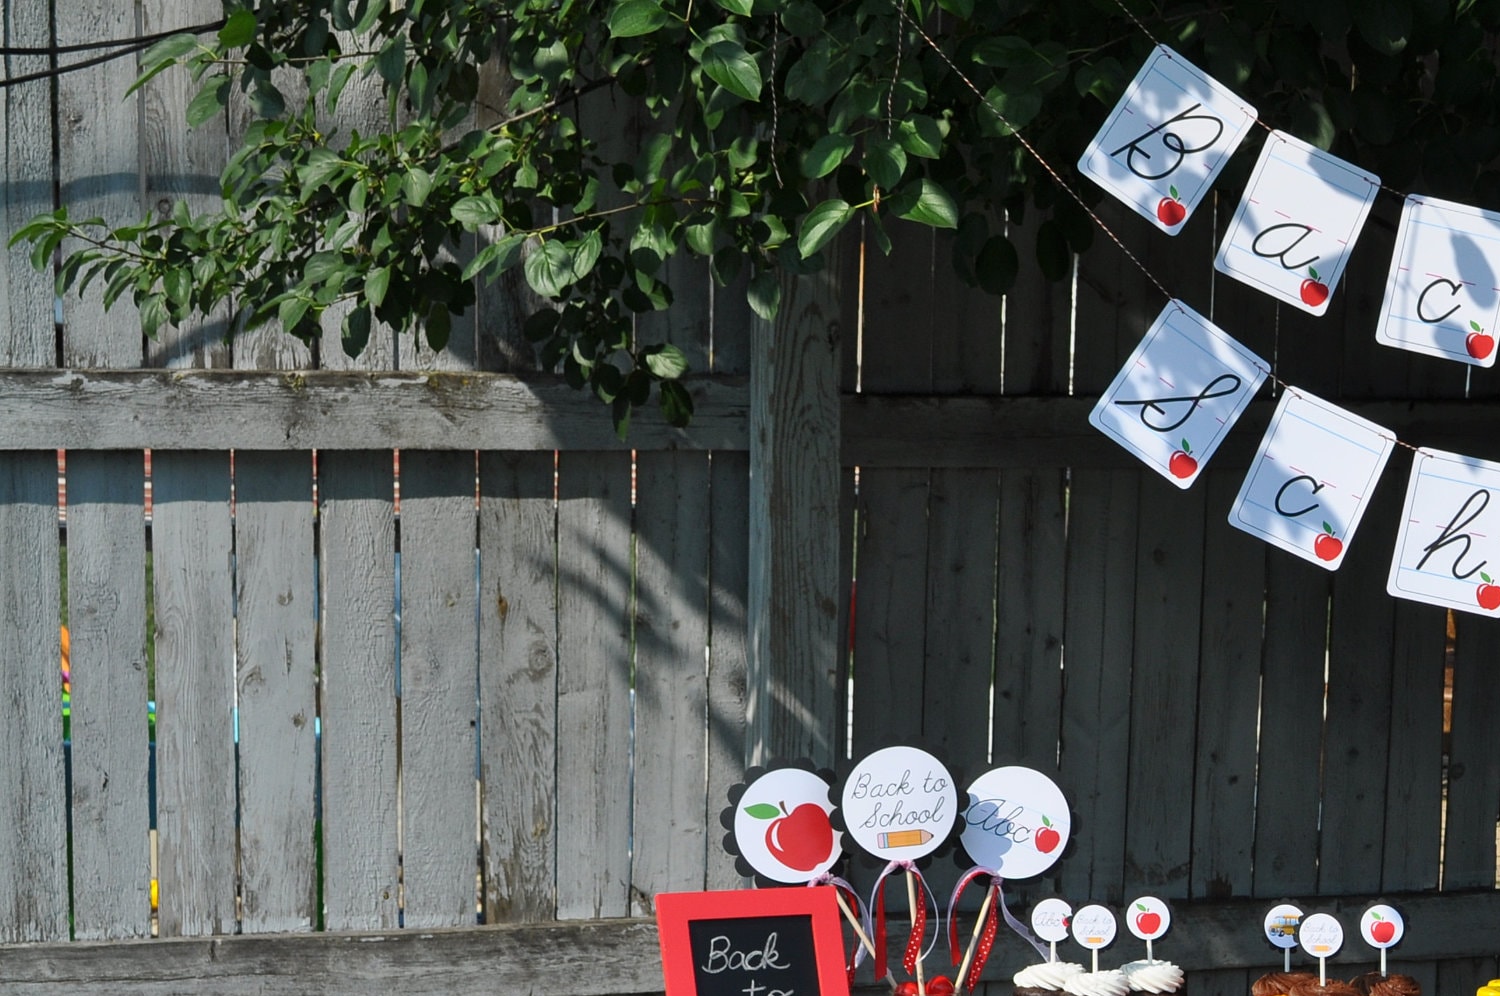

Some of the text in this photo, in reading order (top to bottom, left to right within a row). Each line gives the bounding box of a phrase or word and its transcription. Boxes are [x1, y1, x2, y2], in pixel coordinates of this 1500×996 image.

[851, 769, 948, 800] Back to
[859, 796, 945, 830] School
[966, 798, 1032, 844] Abc
[702, 932, 791, 973] Back
